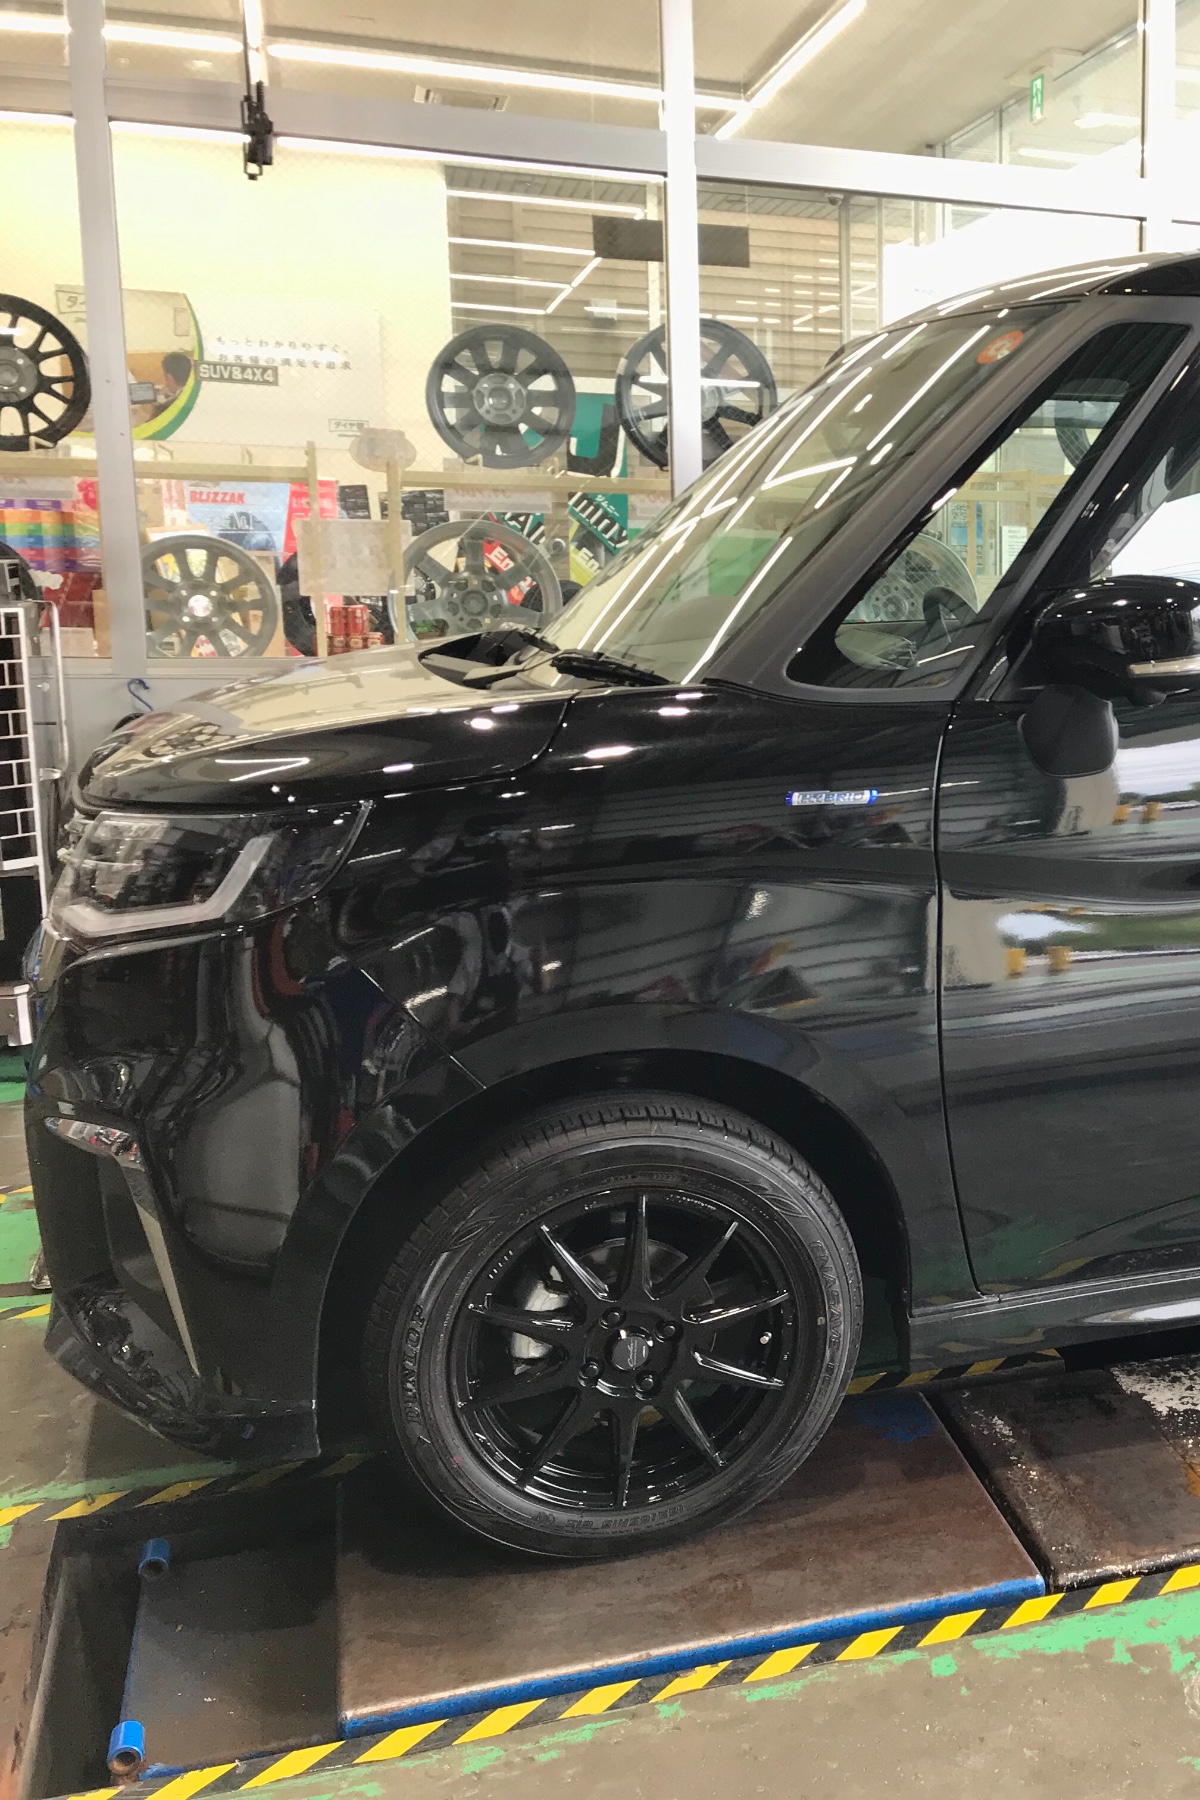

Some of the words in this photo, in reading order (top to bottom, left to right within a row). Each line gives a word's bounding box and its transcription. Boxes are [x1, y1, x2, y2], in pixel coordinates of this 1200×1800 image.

[199, 363, 276, 383] SUV&4X4
[189, 490, 246, 505] BLIZZAK
[595, 494, 620, 517] ジムニー
[402, 1303, 425, 1426] DUNLOP
